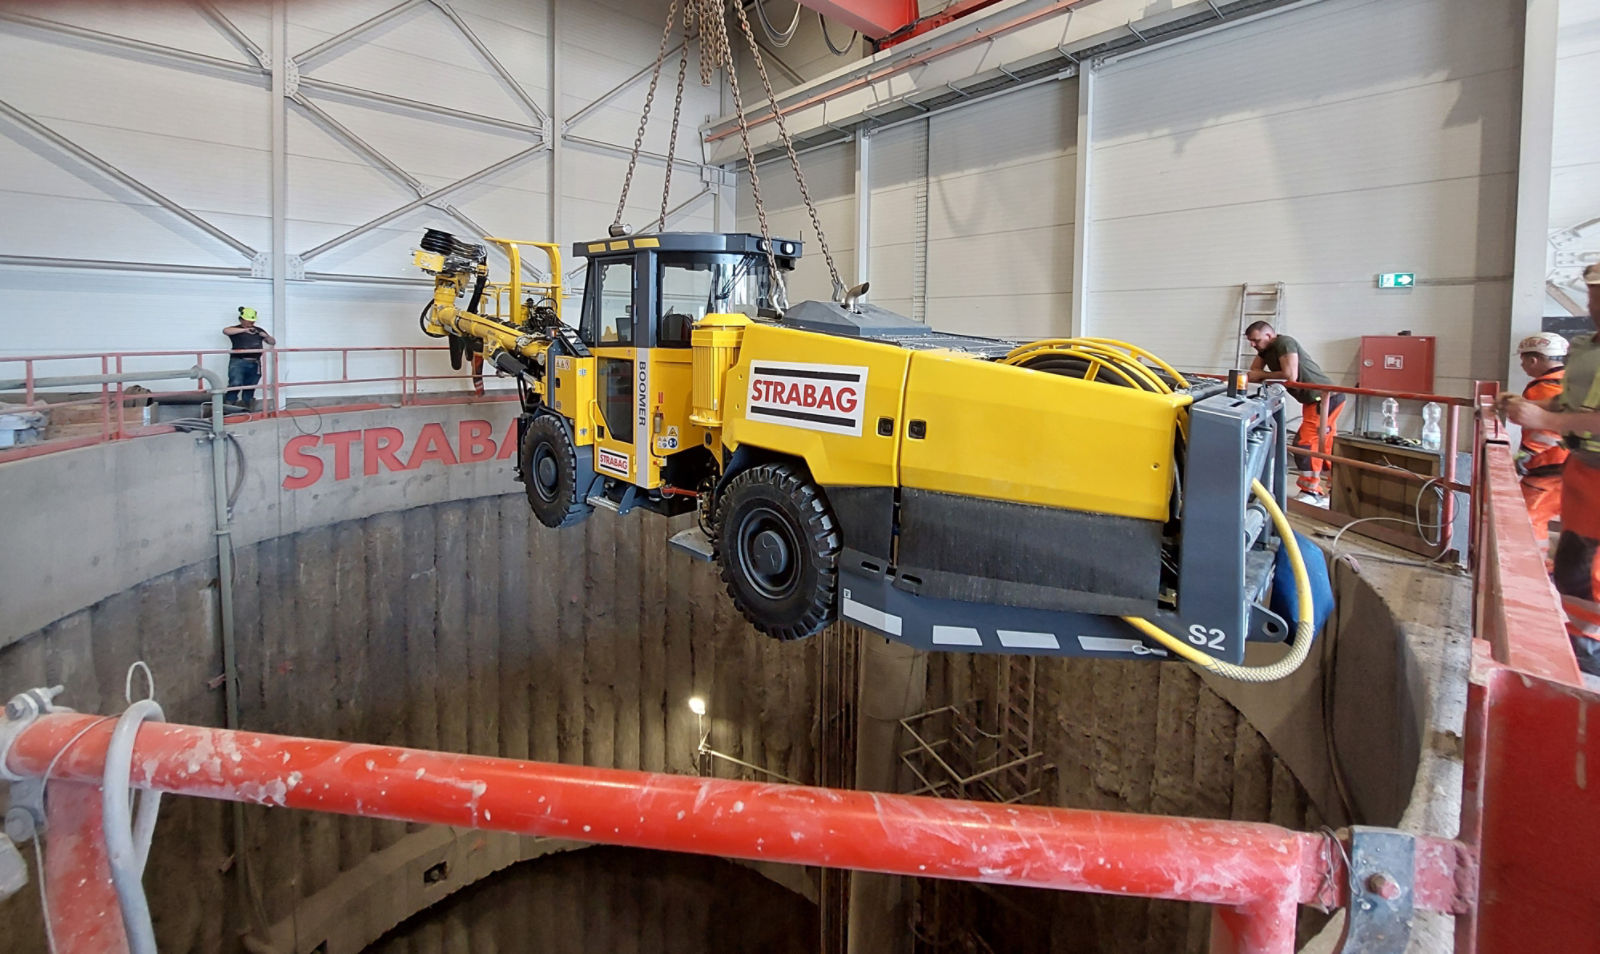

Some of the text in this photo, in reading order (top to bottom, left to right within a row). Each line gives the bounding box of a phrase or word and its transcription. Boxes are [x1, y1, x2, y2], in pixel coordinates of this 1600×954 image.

[638, 361, 647, 427] BOOMER
[751, 379, 858, 413] STRABAG
[600, 454, 628, 470] STRABAG
[1188, 624, 1226, 651] S2
